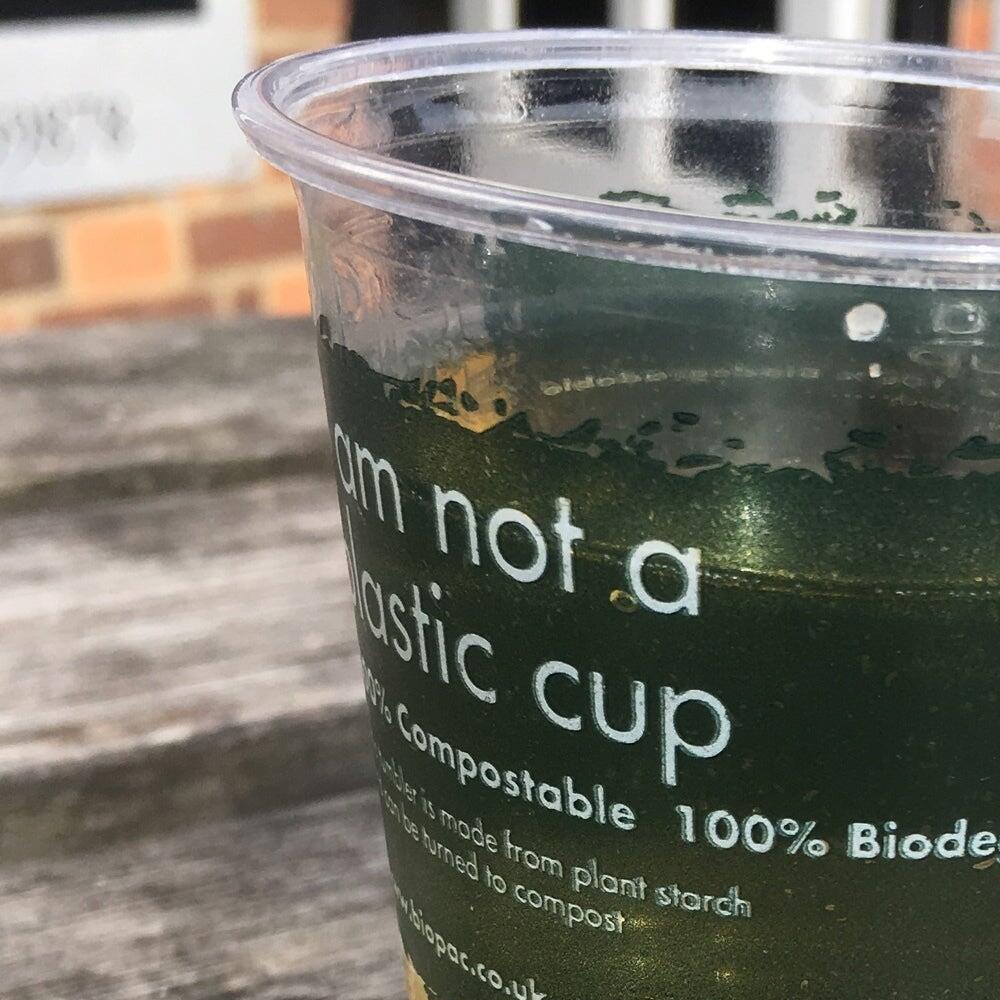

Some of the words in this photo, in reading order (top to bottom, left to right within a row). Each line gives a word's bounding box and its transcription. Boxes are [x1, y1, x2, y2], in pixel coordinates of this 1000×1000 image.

[334, 422, 405, 534] am
[432, 483, 585, 594] not
[626, 539, 701, 616] a
[344, 503, 497, 704] lastic
[532, 660, 732, 787] cup
[397, 702, 638, 831] Compostable
[674, 804, 831, 859] 100%
[421, 826, 479, 882] turned
[484, 864, 508, 894] to
[514, 883, 626, 934] compost
[440, 808, 499, 854] made
[502, 829, 564, 878] from
[571, 858, 649, 901] plant
[654, 885, 752, 919] starch
